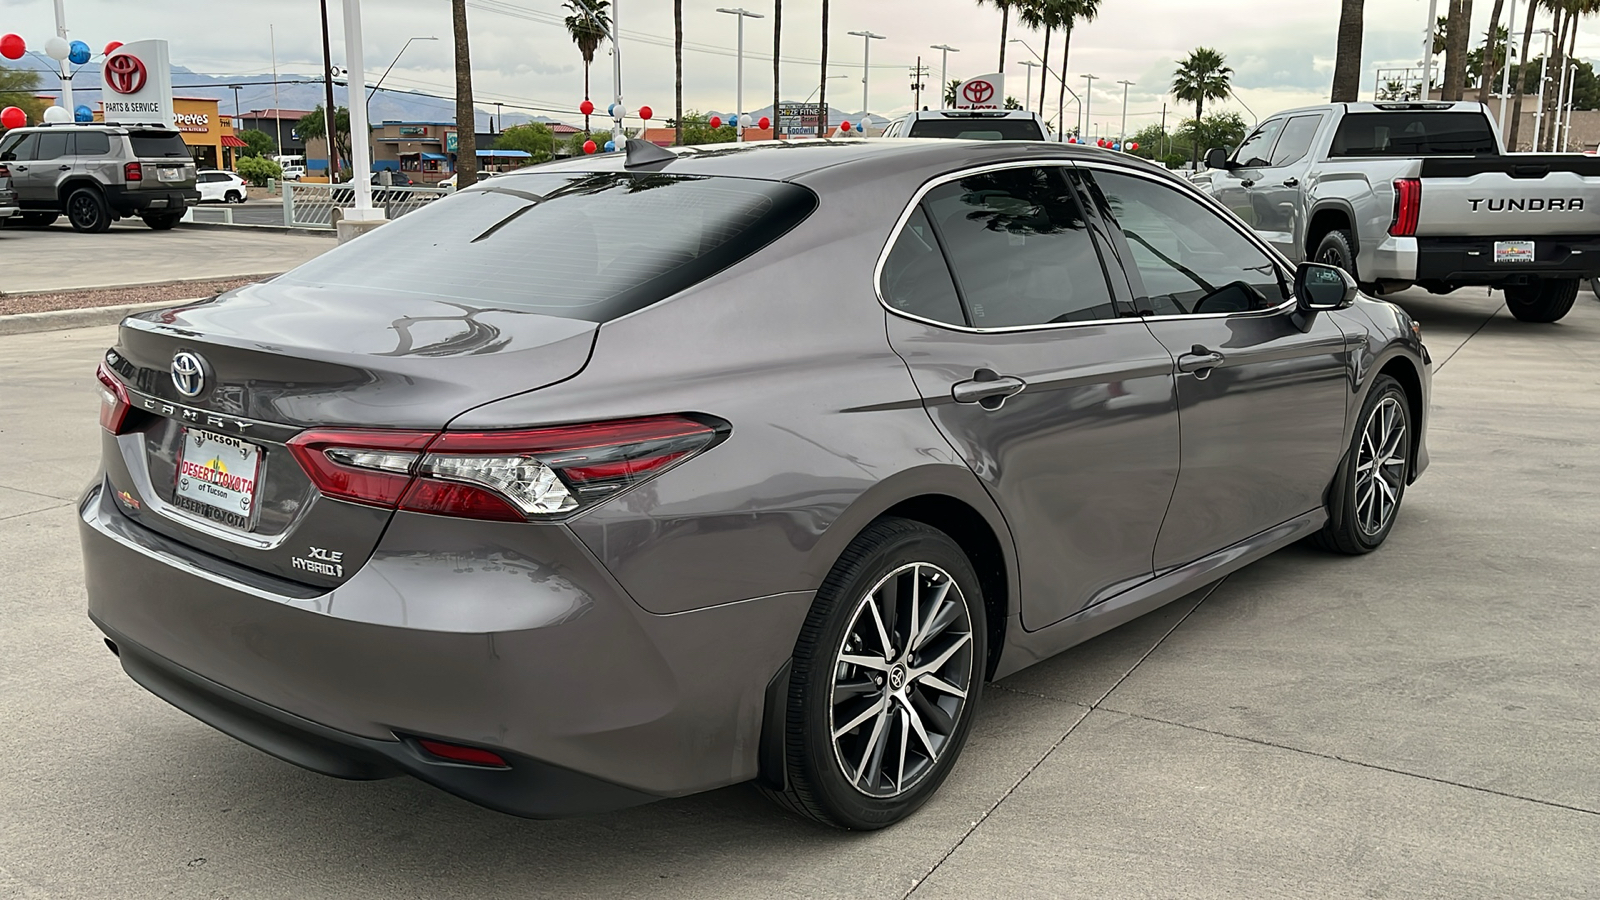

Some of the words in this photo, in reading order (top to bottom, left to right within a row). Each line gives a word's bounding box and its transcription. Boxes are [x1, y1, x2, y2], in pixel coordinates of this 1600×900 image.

[105, 102, 124, 112] PARTS
[124, 102, 131, 112] &
[131, 102, 159, 113] SERVICE
[1467, 198, 1584, 212] TUNDRA
[144, 399, 254, 433] CAMRY
[201, 431, 240, 448] TUCSON
[182, 461, 215, 483] DESERT
[217, 471, 253, 494] TOYOTA
[198, 484, 206, 492] of
[206, 485, 228, 499] Tucson
[175, 497, 206, 515] DESERT
[208, 506, 246, 529] TOYOTA
[308, 546, 344, 563] XLE
[291, 556, 334, 576] HYBRID
